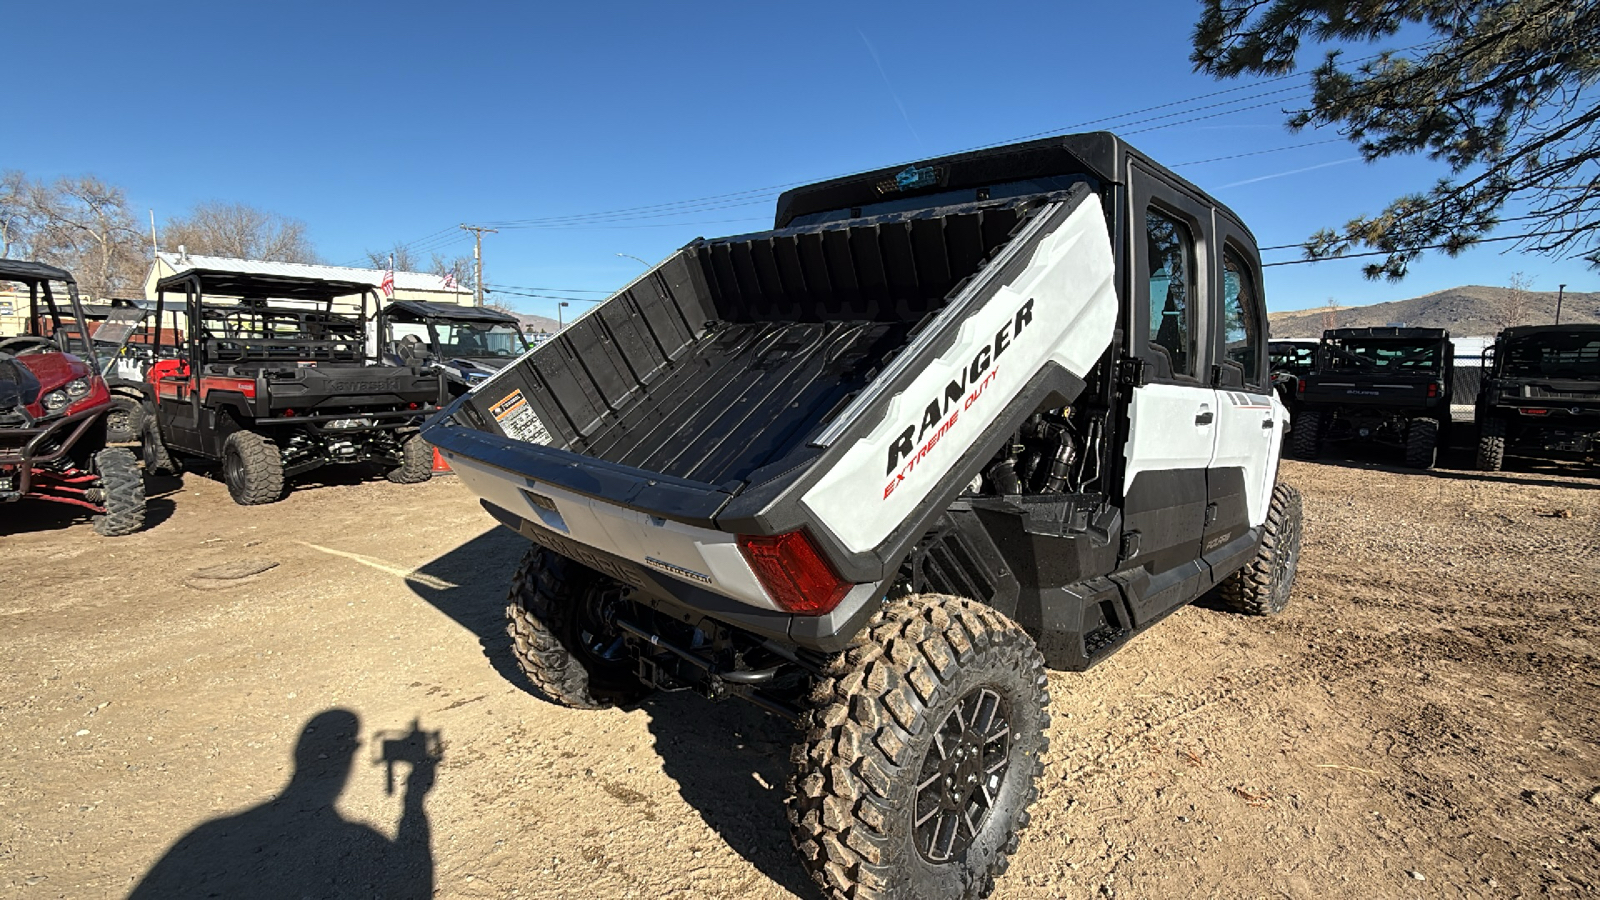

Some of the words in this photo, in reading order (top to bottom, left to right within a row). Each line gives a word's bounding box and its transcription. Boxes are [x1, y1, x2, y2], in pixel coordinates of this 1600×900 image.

[323, 378, 400, 392] Kawasaki
[883, 409, 960, 500] EXTREME
[964, 365, 1000, 412] DUTY
[886, 298, 1034, 477] RANGER
